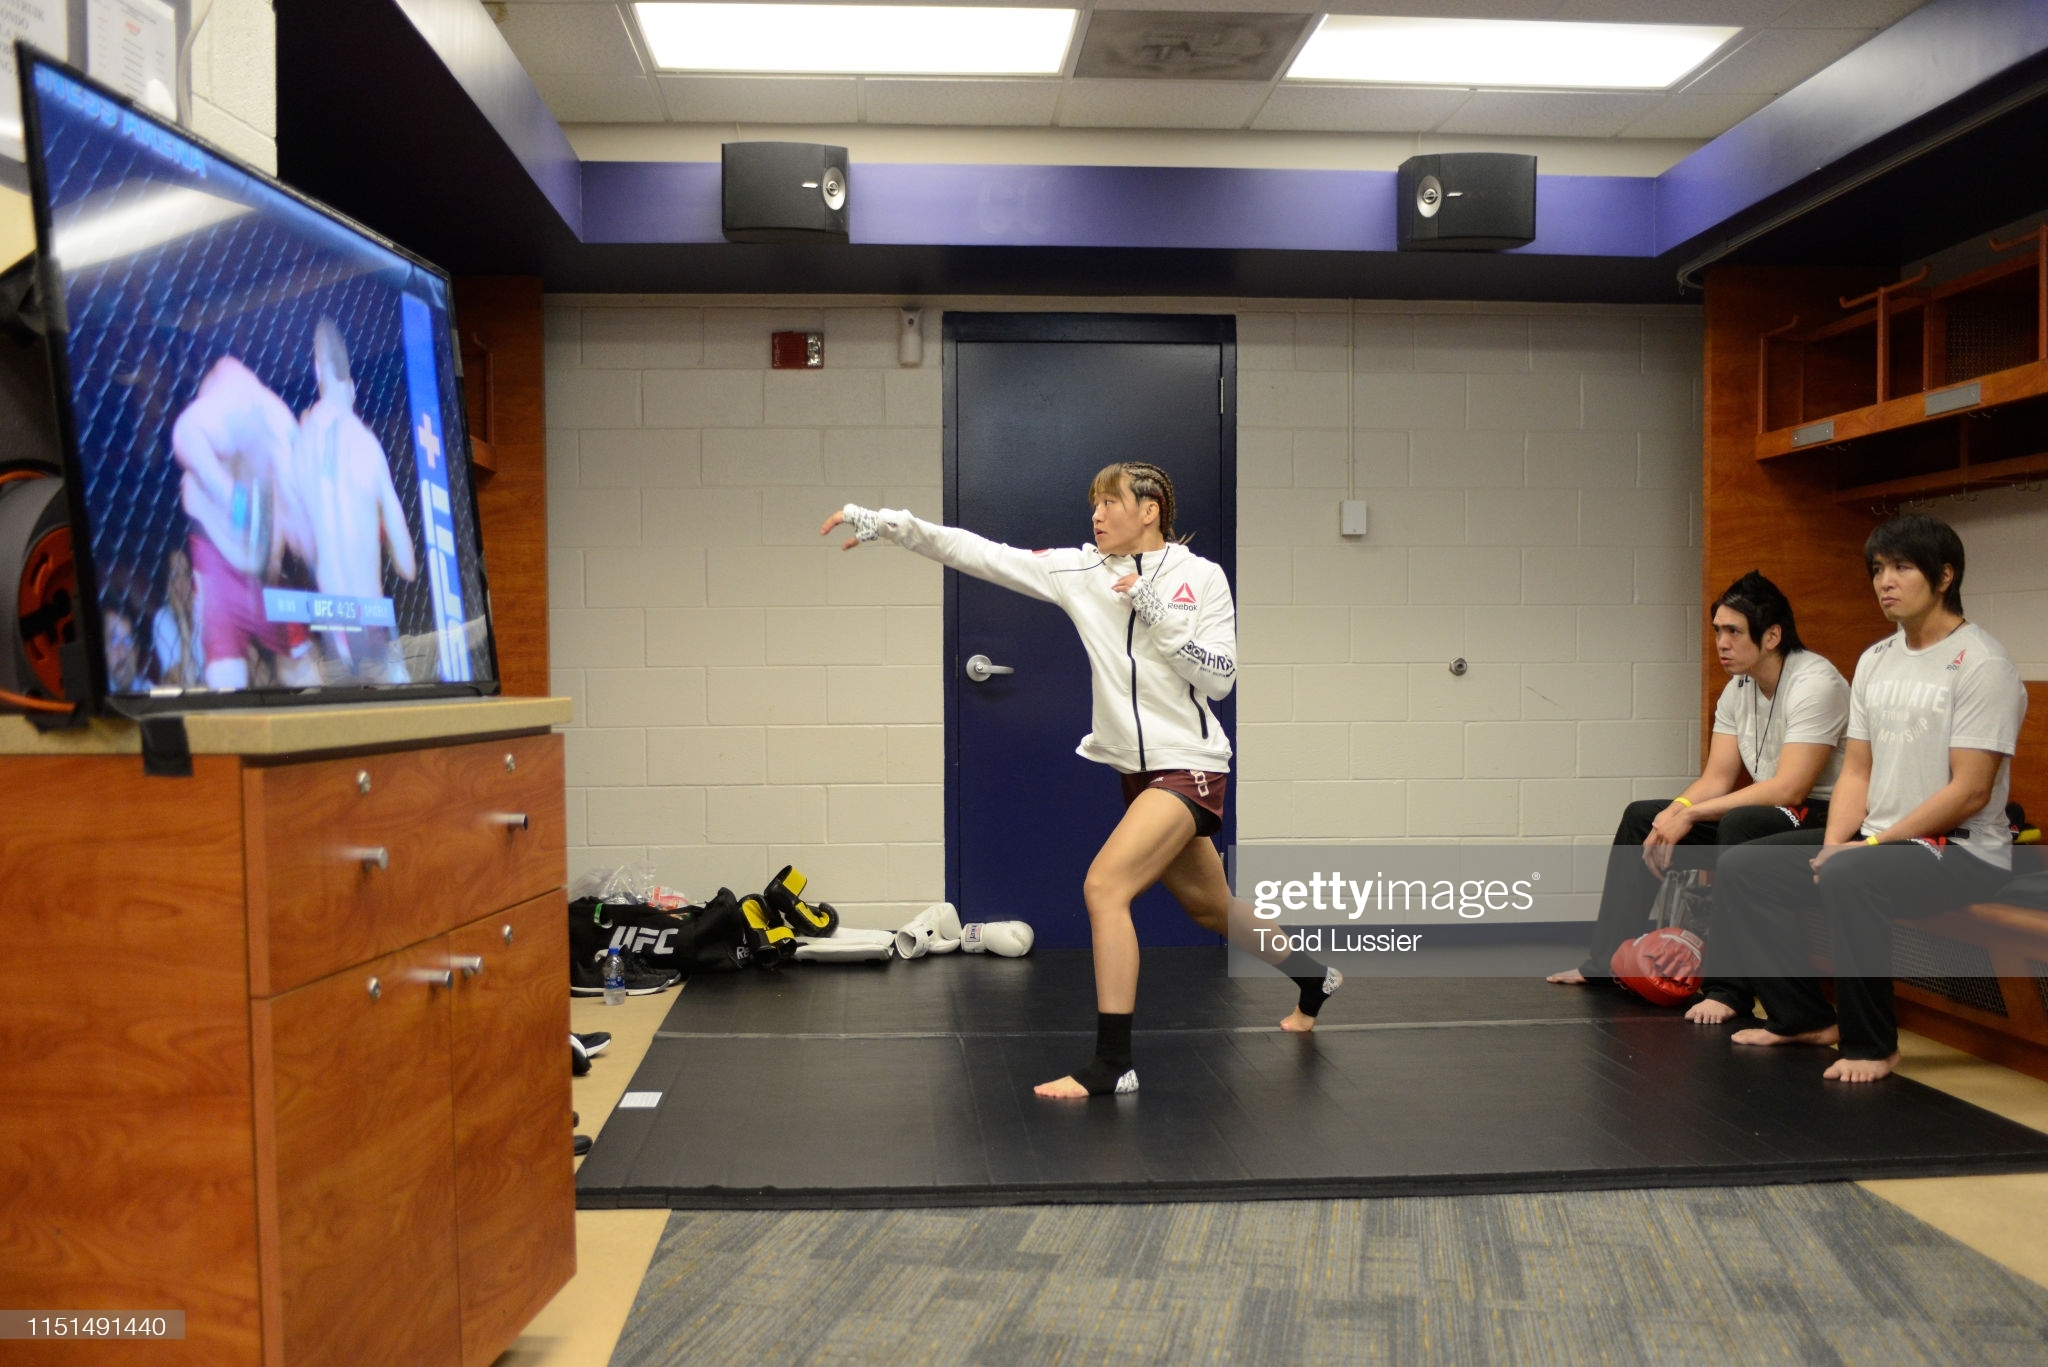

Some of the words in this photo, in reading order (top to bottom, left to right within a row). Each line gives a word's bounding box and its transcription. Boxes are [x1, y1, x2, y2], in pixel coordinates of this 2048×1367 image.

[314, 599, 334, 617] UFC
[1167, 602, 1199, 612] Reebok
[608, 925, 679, 955] UFC
